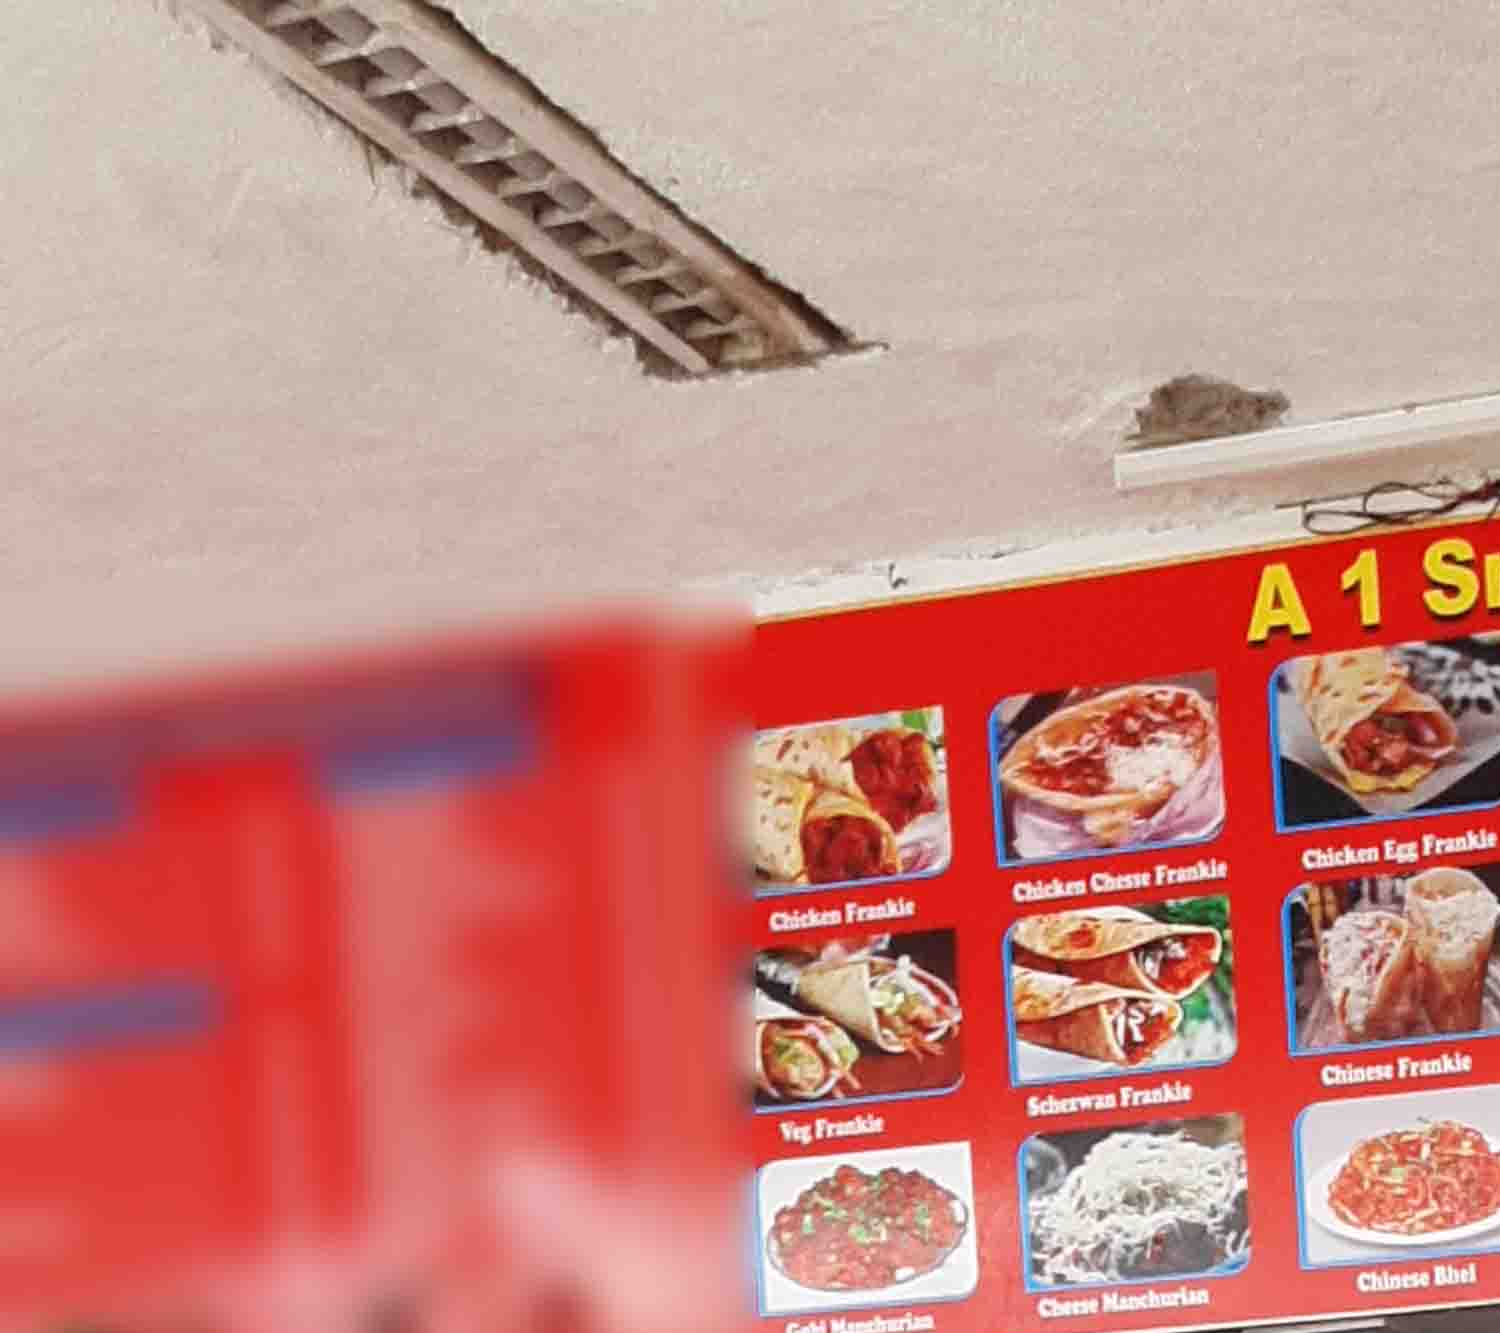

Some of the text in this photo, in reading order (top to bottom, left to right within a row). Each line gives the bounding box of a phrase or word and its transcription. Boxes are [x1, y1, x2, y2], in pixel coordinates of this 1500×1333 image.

[1247, 563, 1311, 641] A
[1341, 550, 1380, 625] 1
[1303, 829, 1498, 870] Chicken Egg Frankie
[1013, 877, 1085, 903] Chicken
[1155, 859, 1227, 885] Frankie
[769, 897, 915, 933] Chicken Frankie
[1321, 1053, 1472, 1086] Chinese Frankie
[1120, 1081, 1191, 1107] Frankie
[780, 1113, 884, 1145] Veg Frankie
[1357, 1263, 1477, 1293] Chinese Bhel
[1103, 1286, 1209, 1313] Manchurian
